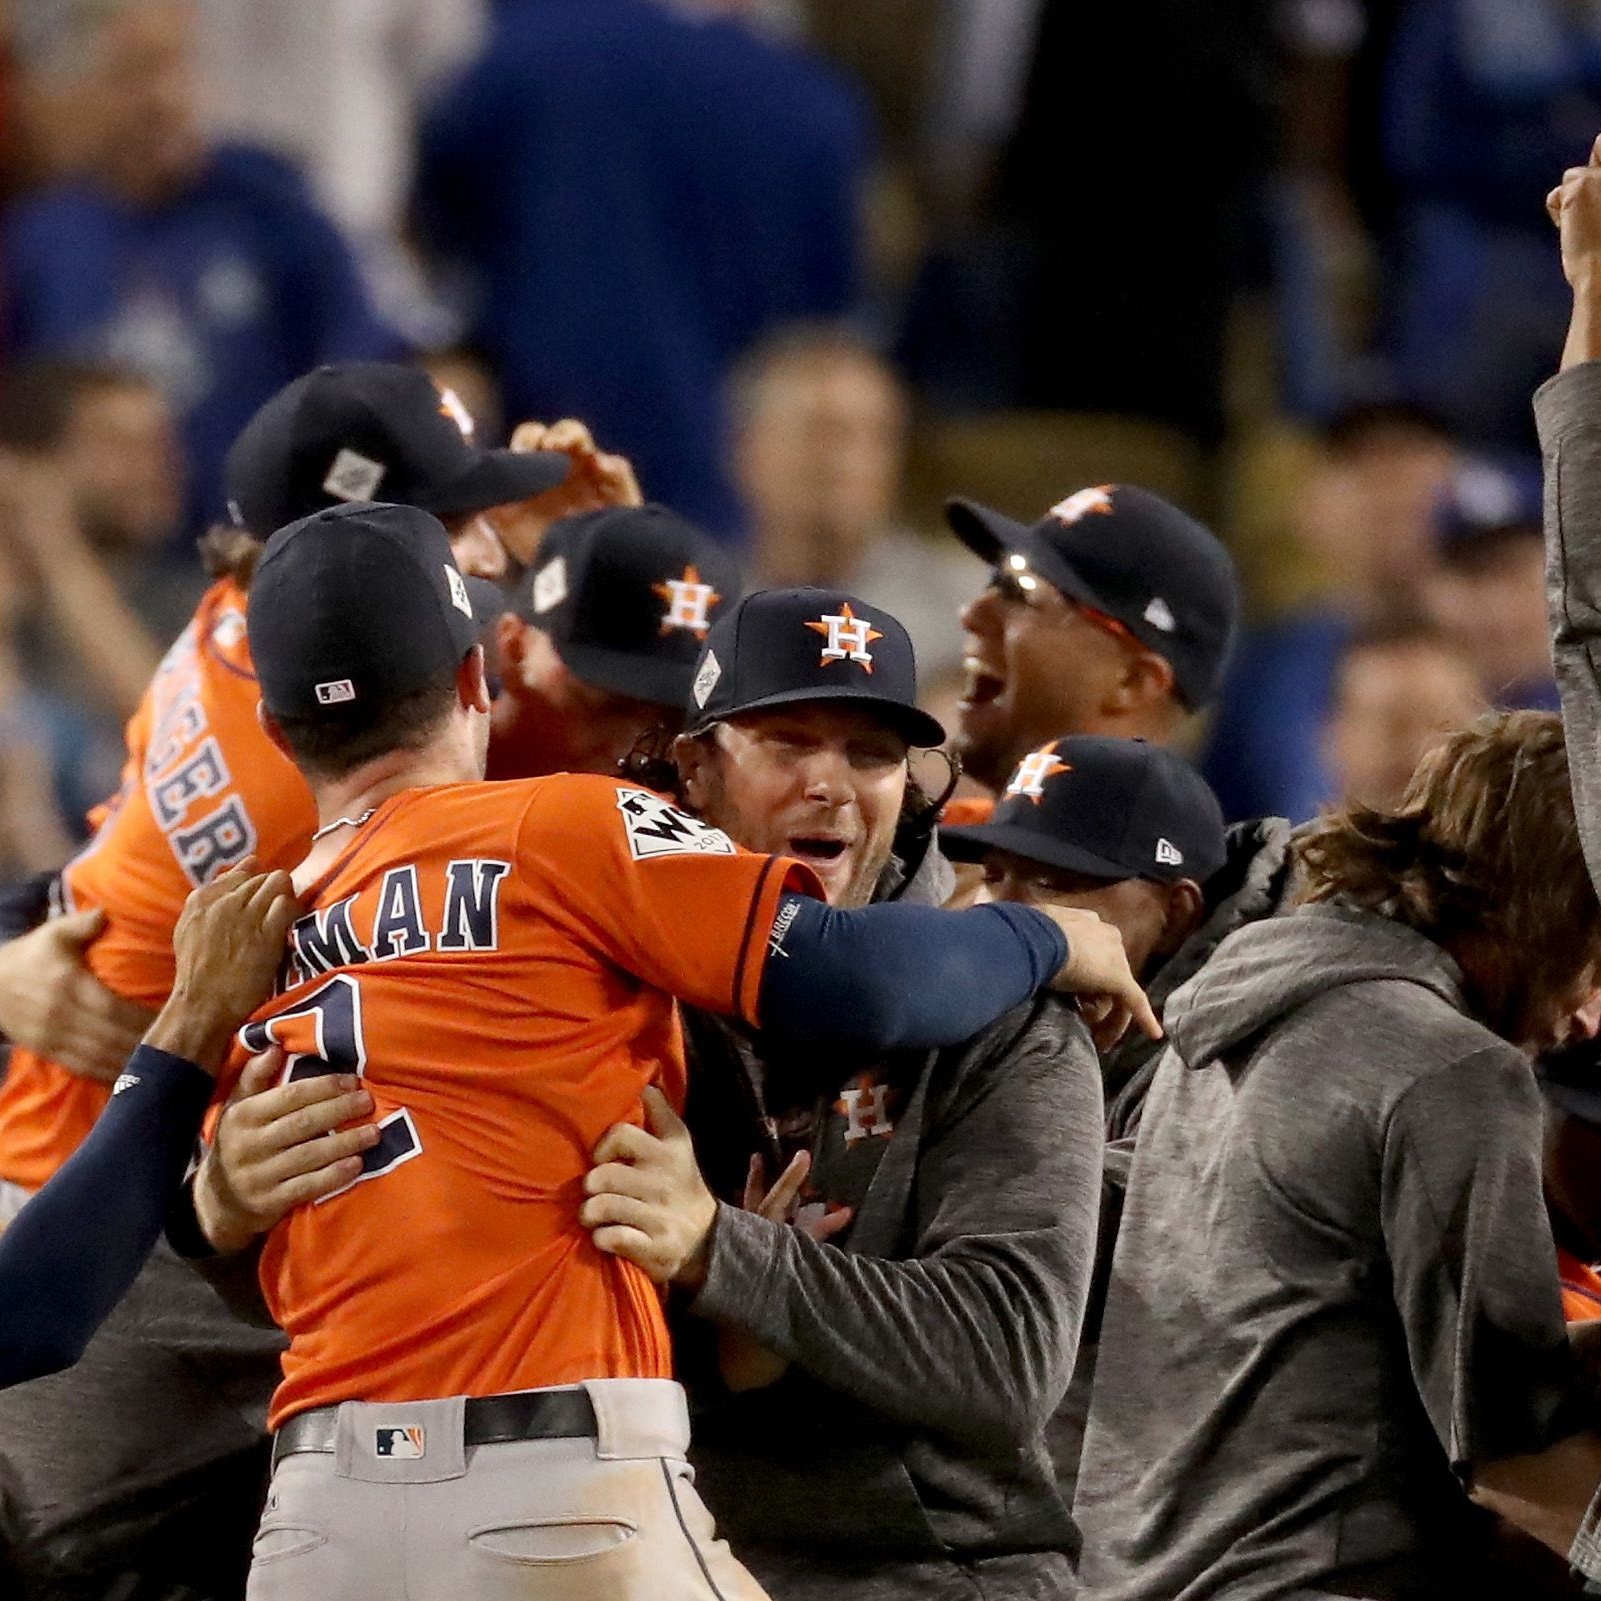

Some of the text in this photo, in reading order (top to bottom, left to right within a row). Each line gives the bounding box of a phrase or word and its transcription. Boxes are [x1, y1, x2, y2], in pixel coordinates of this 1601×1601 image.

[661, 579, 715, 630] H
[821, 615, 873, 663] H
[1006, 752, 1063, 797] H
[273, 859, 512, 997] MAN
[840, 1084, 894, 1142] H
